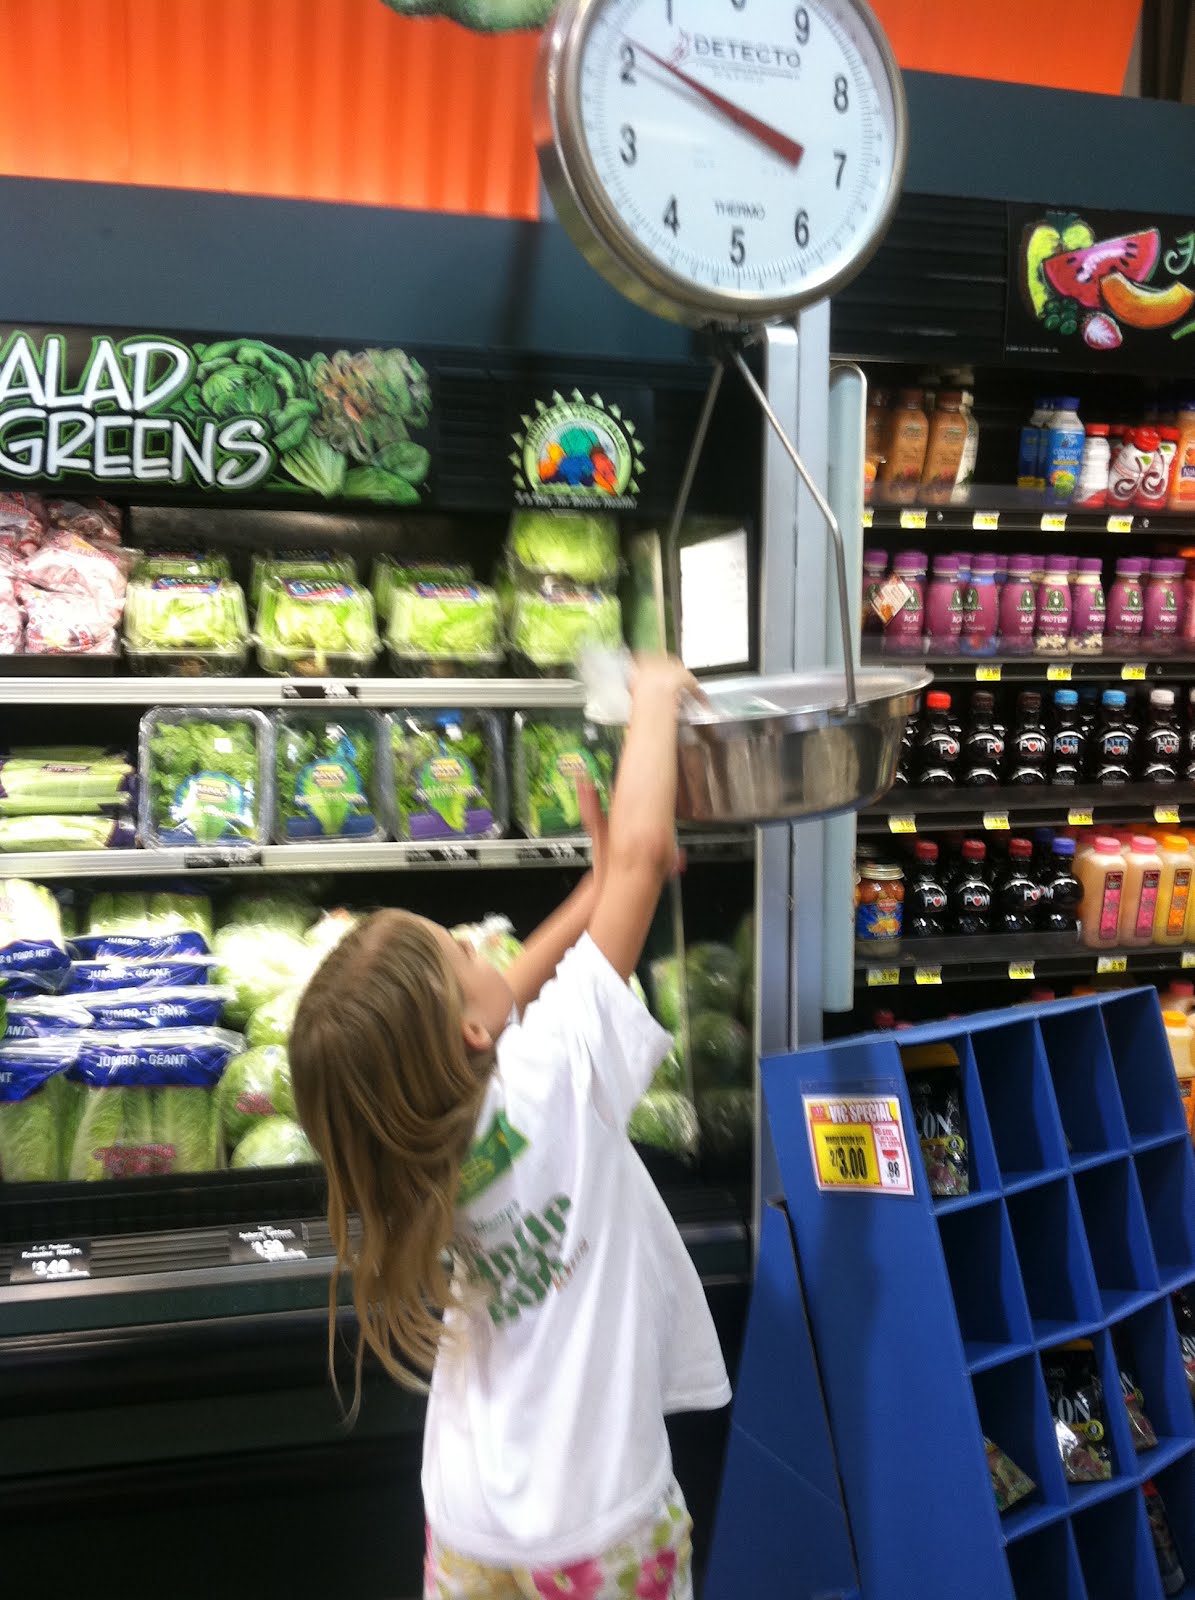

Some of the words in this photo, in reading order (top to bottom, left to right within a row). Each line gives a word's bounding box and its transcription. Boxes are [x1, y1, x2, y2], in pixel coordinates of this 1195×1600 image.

[794, 7, 810, 45] 9
[693, 34, 801, 69] DETECTO
[620, 45, 636, 86] 2
[833, 75, 849, 113] 8
[620, 124, 637, 166] 3
[833, 151, 847, 190] 7
[663, 194, 680, 237] 4
[794, 210, 809, 250] 6
[729, 229, 746, 267] 5
[0, 334, 193, 412] ALAD
[0, 407, 268, 490] GREENS
[1019, 740, 1045, 753] POM
[1054, 744, 1079, 755] POM
[1055, 737, 1079, 745] LITE
[1104, 738, 1129, 746] LITE
[1157, 737, 1180, 746] LITE
[1104, 745, 1128, 755] POM
[925, 896, 948, 908] POM
[964, 895, 991, 908] POM
[105, 936, 139, 946] JUMBO
[35, 948, 51, 958] NET
[6, 1025, 29, 1036] ANT
[97, 1054, 137, 1067] JUMBO
[828, 1104, 849, 1123] VIC
[849, 1102, 893, 1122] SPECIAL
